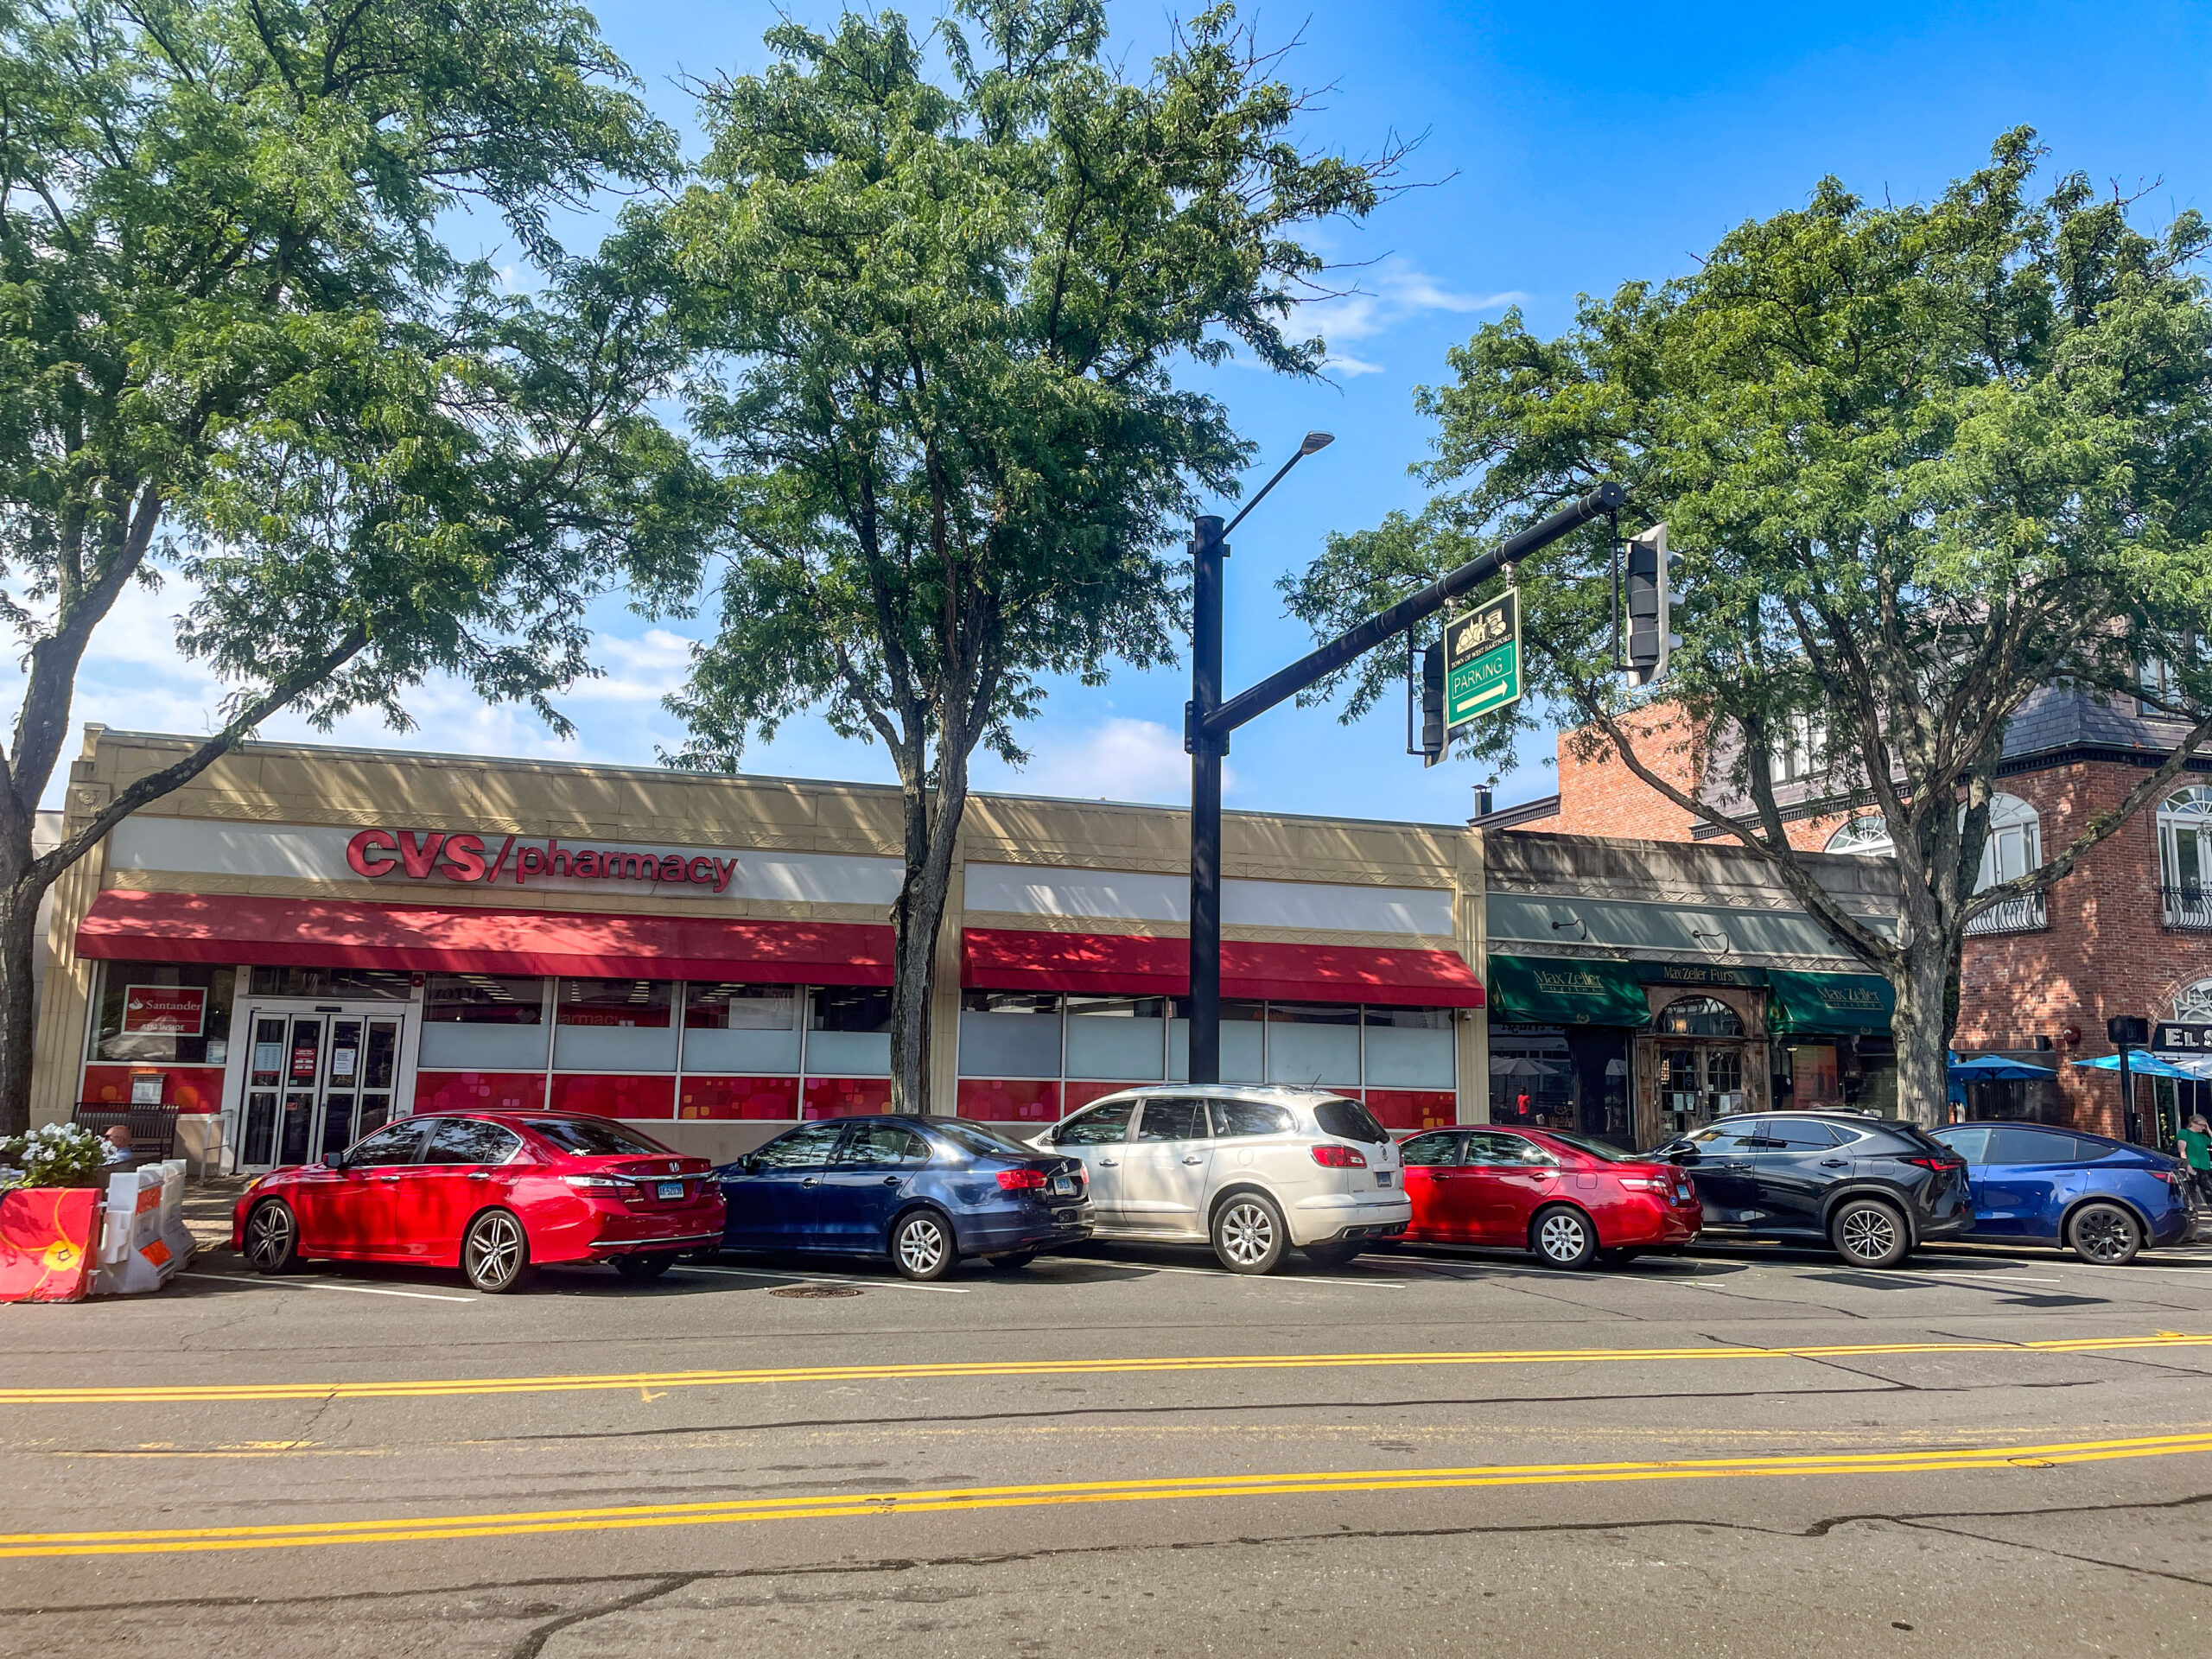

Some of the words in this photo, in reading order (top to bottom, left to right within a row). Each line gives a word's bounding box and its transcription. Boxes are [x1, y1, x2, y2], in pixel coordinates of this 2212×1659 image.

[1451, 658, 1465, 669] TOWN
[1471, 647, 1484, 657] WEST
[1484, 633, 1512, 652] HARTFORD
[1454, 658, 1503, 694] PARKING
[1533, 970, 1565, 984] Max
[1564, 971, 1603, 986] Zeller
[1663, 967, 1682, 980] Max
[1682, 968, 1707, 981] Zeller
[1711, 969, 1734, 982] Furs
[1816, 987, 1847, 1000] Max
[1844, 988, 1880, 1001] Zeller
[146, 1000, 202, 1011] Santander
